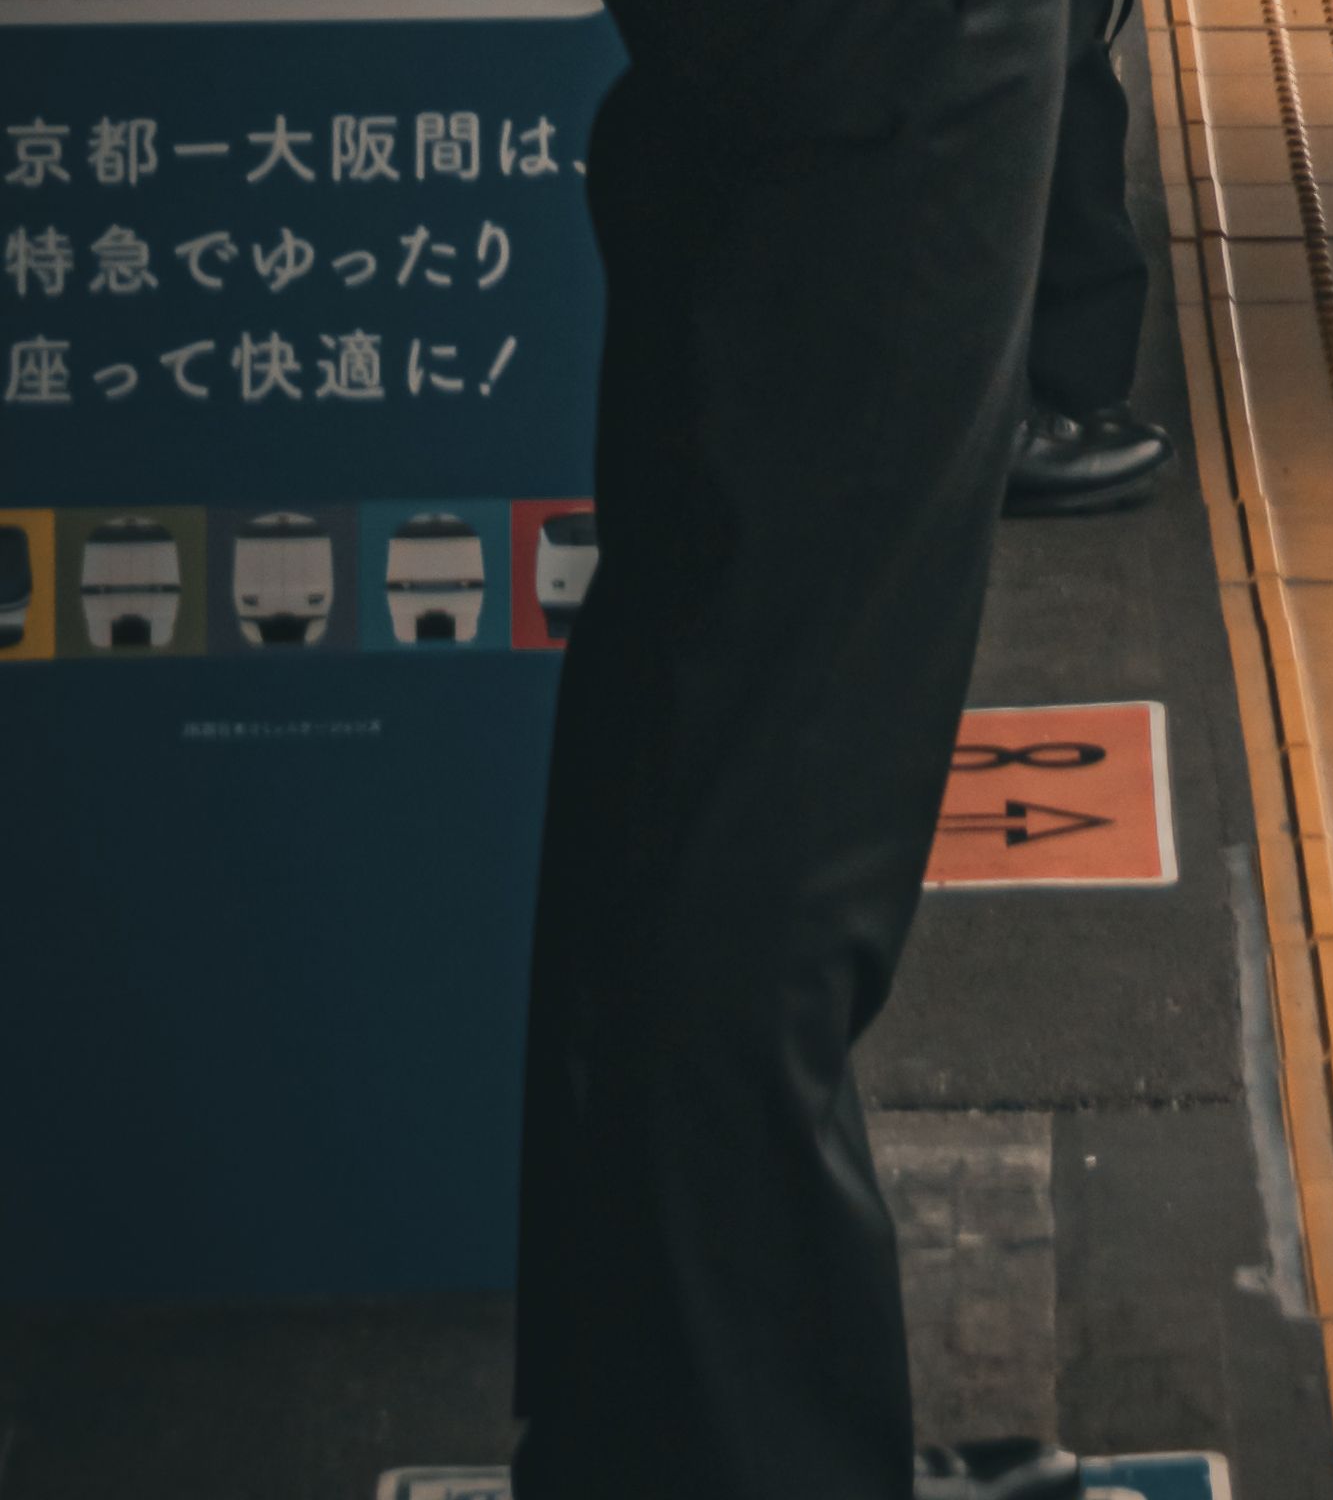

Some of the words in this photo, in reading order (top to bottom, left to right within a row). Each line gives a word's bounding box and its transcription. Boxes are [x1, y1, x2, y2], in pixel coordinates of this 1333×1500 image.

[4, 220, 512, 298] 特急でゆったり
